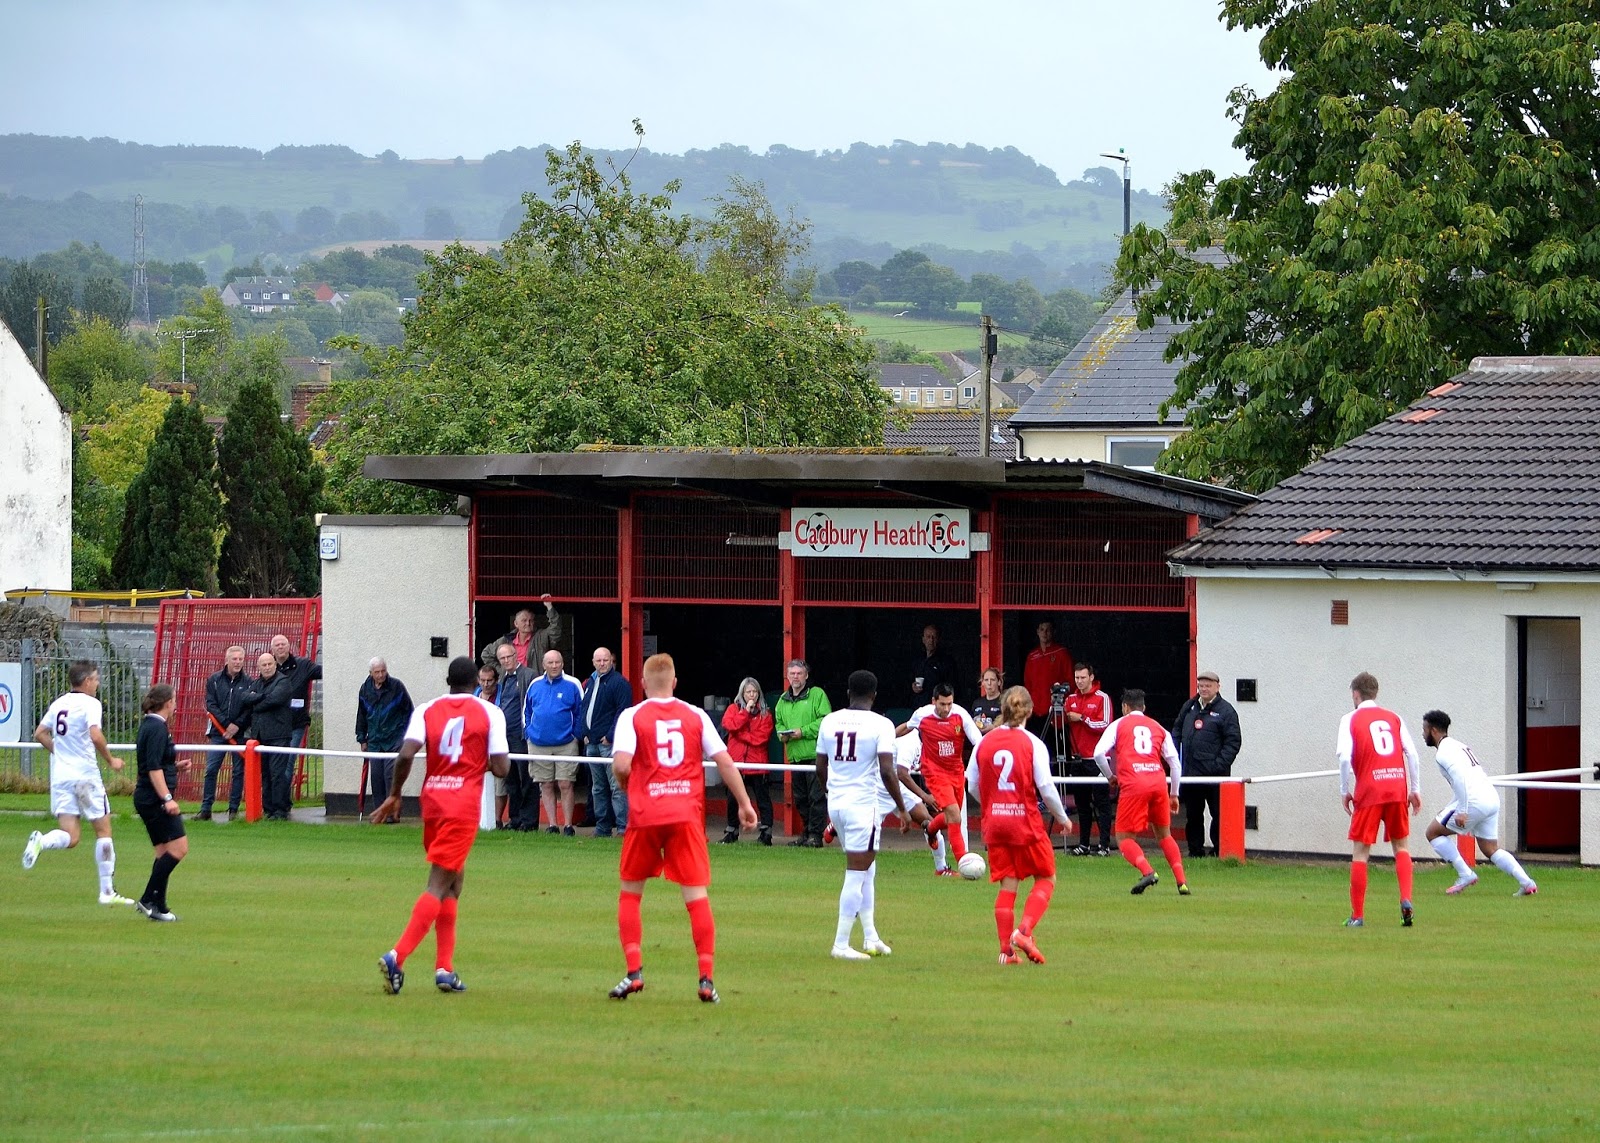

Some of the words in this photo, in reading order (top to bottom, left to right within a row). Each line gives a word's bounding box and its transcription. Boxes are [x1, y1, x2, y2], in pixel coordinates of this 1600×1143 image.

[795, 519, 868, 552] Cadbury
[874, 520, 927, 546] Heath
[931, 521, 966, 547] F.C.
[56, 709, 69, 736] 6
[1369, 720, 1395, 756] 6
[439, 716, 465, 764] 4
[656, 719, 685, 768] 5
[834, 731, 857, 761] 11
[1133, 725, 1153, 755] 8
[993, 749, 1016, 791] 2
